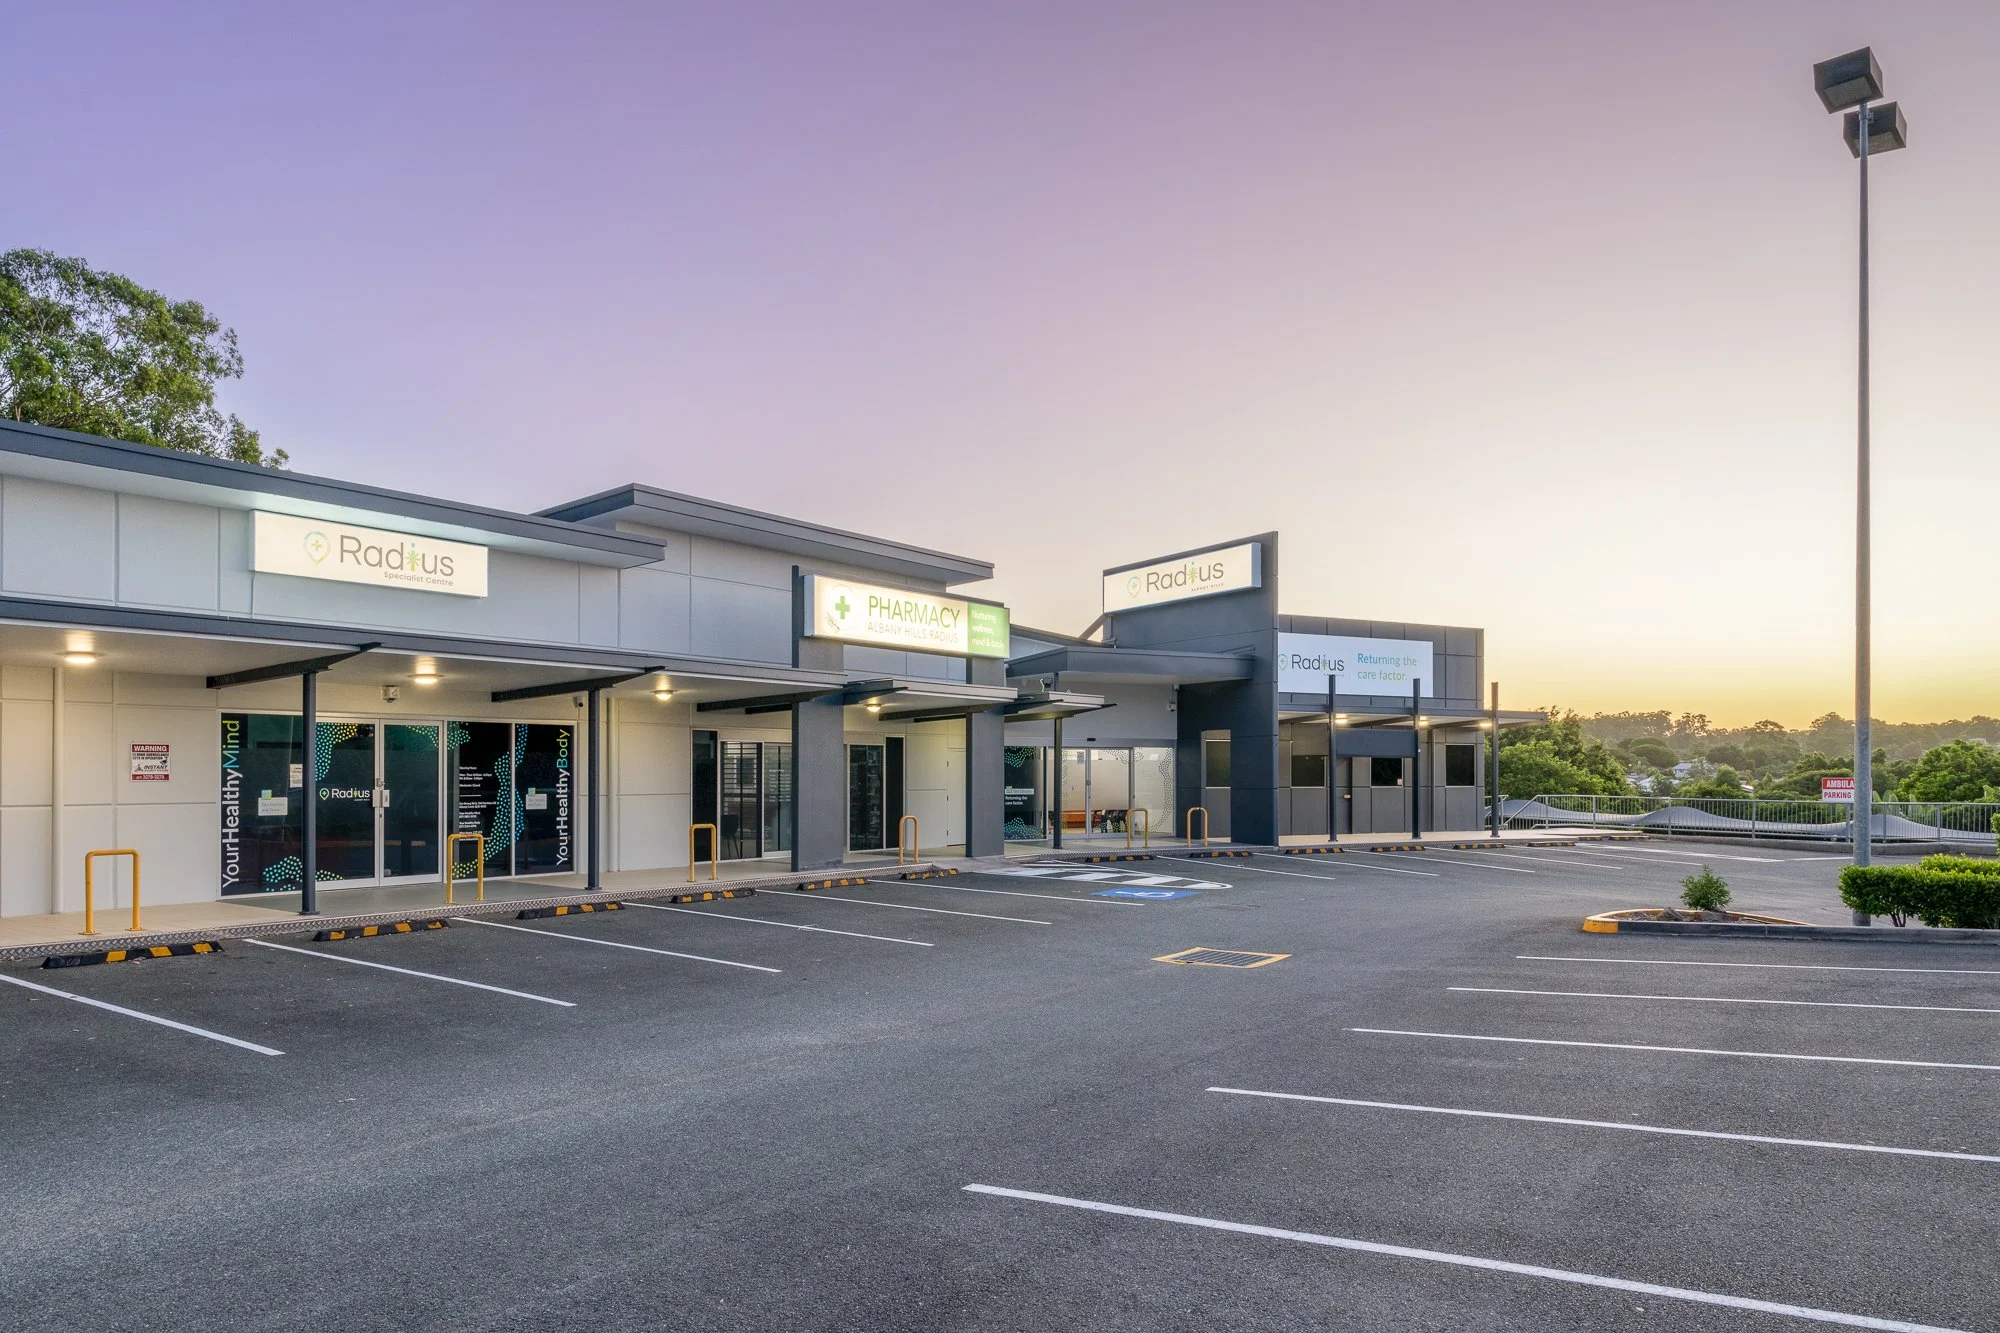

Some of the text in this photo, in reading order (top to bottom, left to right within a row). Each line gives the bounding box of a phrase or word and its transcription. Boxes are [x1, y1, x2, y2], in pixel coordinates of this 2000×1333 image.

[339, 534, 455, 577] Radius
[383, 571, 454, 587] Specialist Centre
[1146, 561, 1224, 593] Radius
[868, 595, 961, 629] PHARMACY
[868, 622, 959, 643] ALBANY HILLS RADIUS
[1291, 654, 1345, 672] Radius
[1357, 653, 1417, 668] Returning the
[1358, 670, 1408, 681] care factor.
[331, 787, 371, 799] Radius
